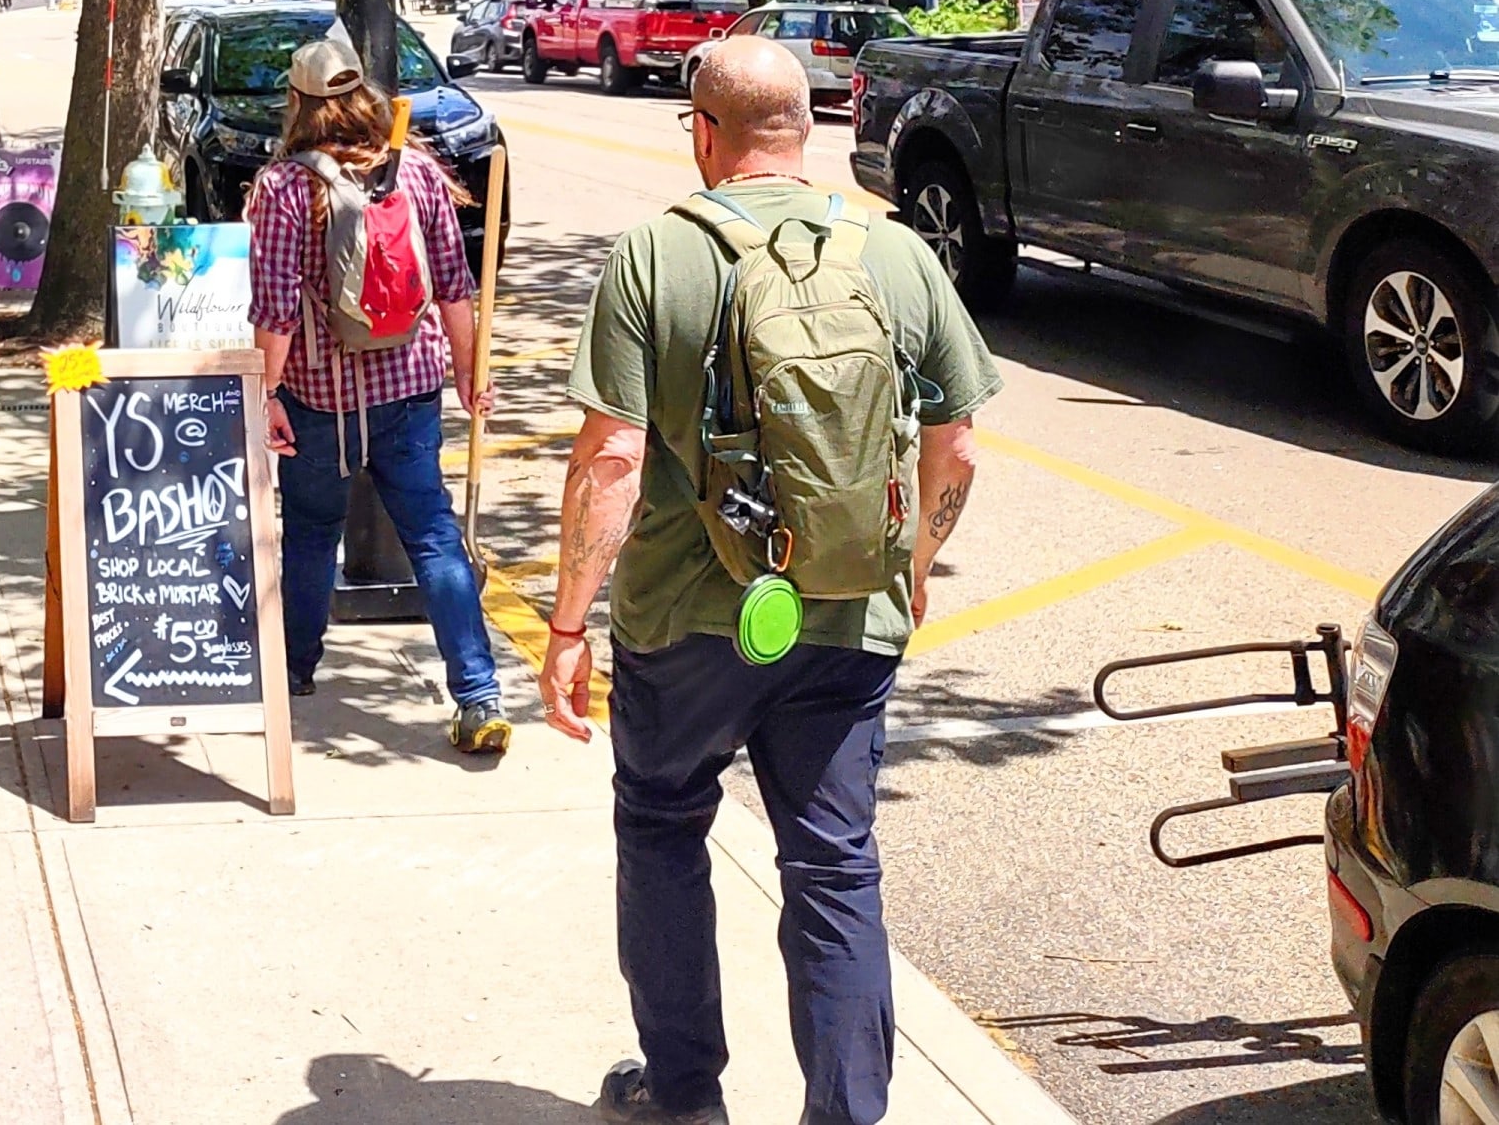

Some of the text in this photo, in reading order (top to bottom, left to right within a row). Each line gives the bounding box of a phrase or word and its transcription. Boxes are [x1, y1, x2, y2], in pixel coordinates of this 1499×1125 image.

[158, 265, 245, 322] Wildflower
[158, 322, 243, 333] BOUTIQUE
[86, 391, 164, 479] YS
[163, 391, 225, 415] MERCH
[175, 418, 208, 447] @
[98, 557, 211, 578] SHOP LOCAL
[95, 582, 145, 605] BRICK
[159, 583, 222, 606] MORTAR
